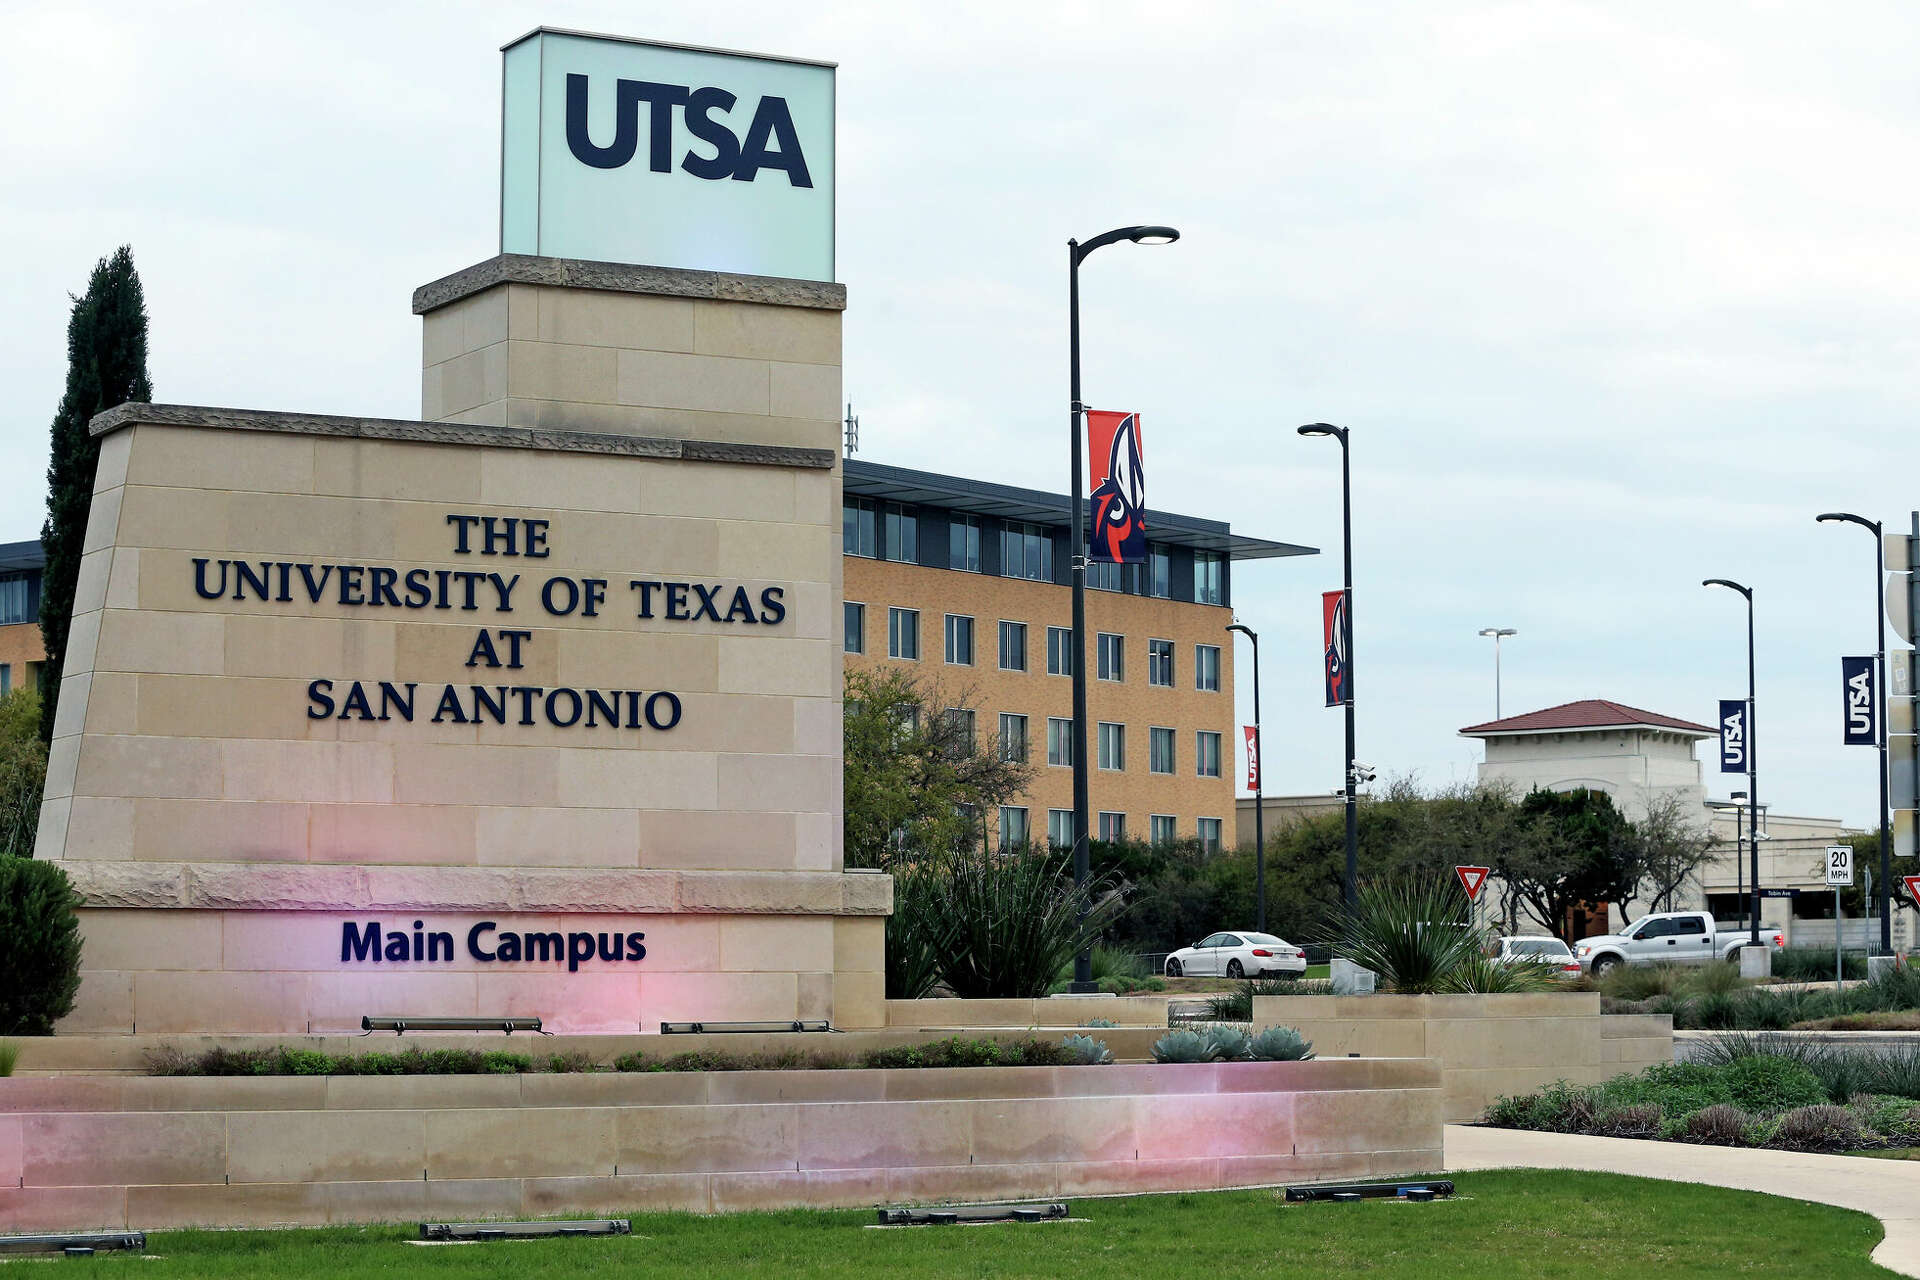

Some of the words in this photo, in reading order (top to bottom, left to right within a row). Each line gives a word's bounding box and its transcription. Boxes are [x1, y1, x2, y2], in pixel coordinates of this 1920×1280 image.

[566, 73, 814, 188] UTSA
[447, 514, 550, 558] THE
[192, 558, 520, 612] UNIVERSITY
[541, 577, 607, 617] OF
[630, 580, 786, 625] TEXAS
[465, 628, 531, 669] AT
[307, 679, 417, 721] SAN
[431, 685, 682, 731] ANTONIO
[1848, 672, 1870, 734] UTSA
[1248, 737, 1257, 783] UTSA
[1724, 712, 1743, 764] UTSA
[1831, 851, 1848, 868] 20
[1831, 870, 1849, 880] MPH
[341, 920, 454, 962] Main
[467, 921, 647, 972] Campus
